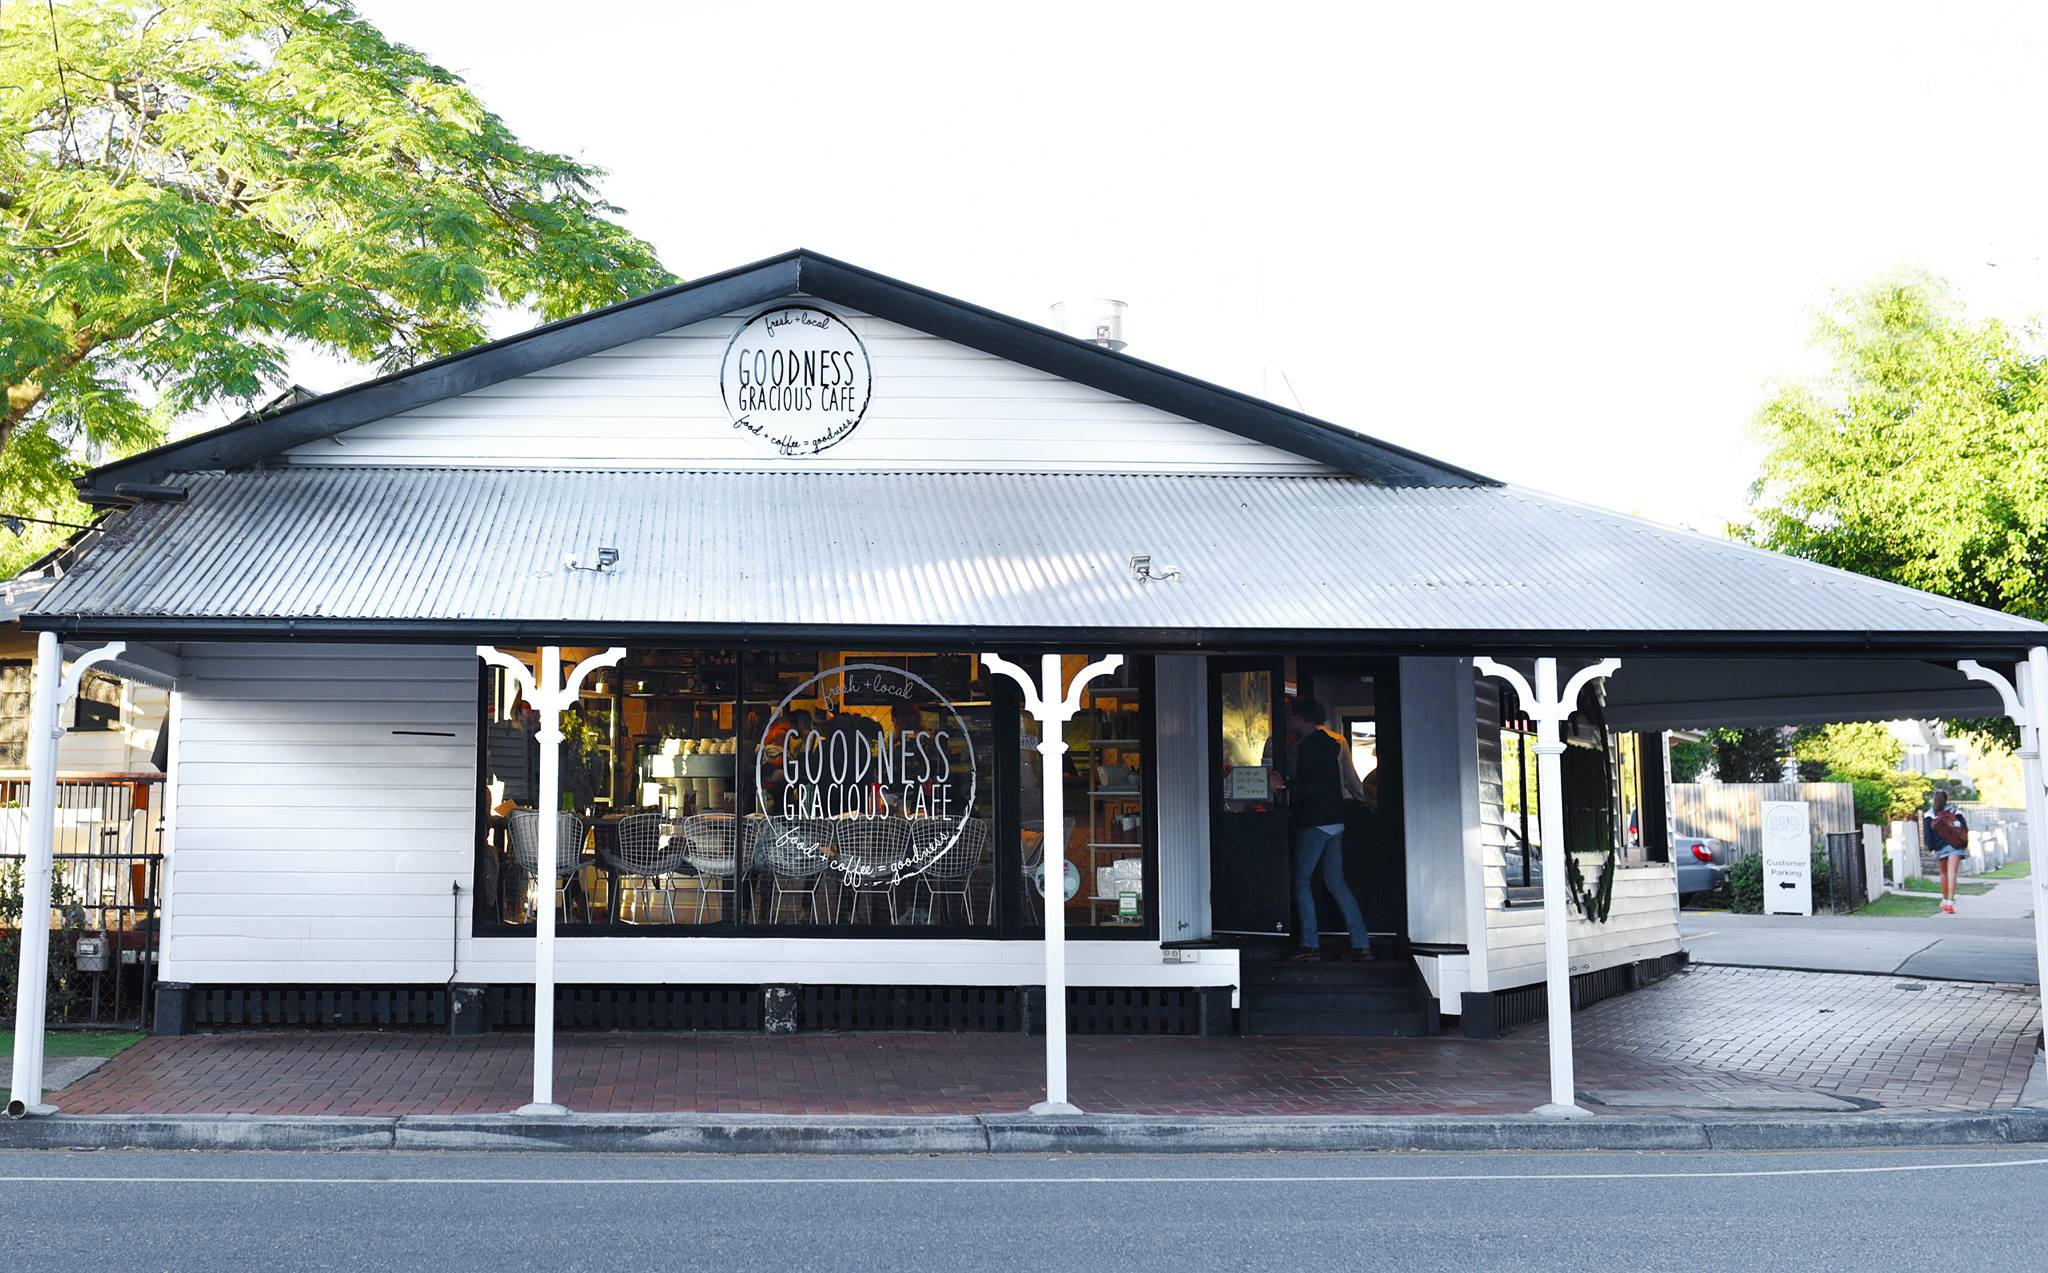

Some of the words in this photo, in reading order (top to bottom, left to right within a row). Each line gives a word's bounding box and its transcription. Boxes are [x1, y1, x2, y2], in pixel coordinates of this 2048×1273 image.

[766, 312, 792, 337] fresh
[802, 312, 829, 329] local
[739, 349, 854, 387] GOODNESS
[739, 386, 812, 411] GRACIOUS
[821, 386, 855, 411] CAFE
[733, 415, 763, 436] food
[771, 435, 800, 455] coffee
[812, 418, 854, 454] goodness
[822, 674, 860, 711] fresh
[873, 674, 913, 699] local
[783, 729, 949, 784] GOODNESS
[783, 784, 889, 820] GRACIOUS
[903, 784, 952, 820] CAFE
[776, 826, 819, 858] food
[830, 856, 874, 887] coffee
[891, 831, 950, 885] goodness
[1766, 859, 1806, 868] Customer
[1771, 869, 1802, 878] Parking
